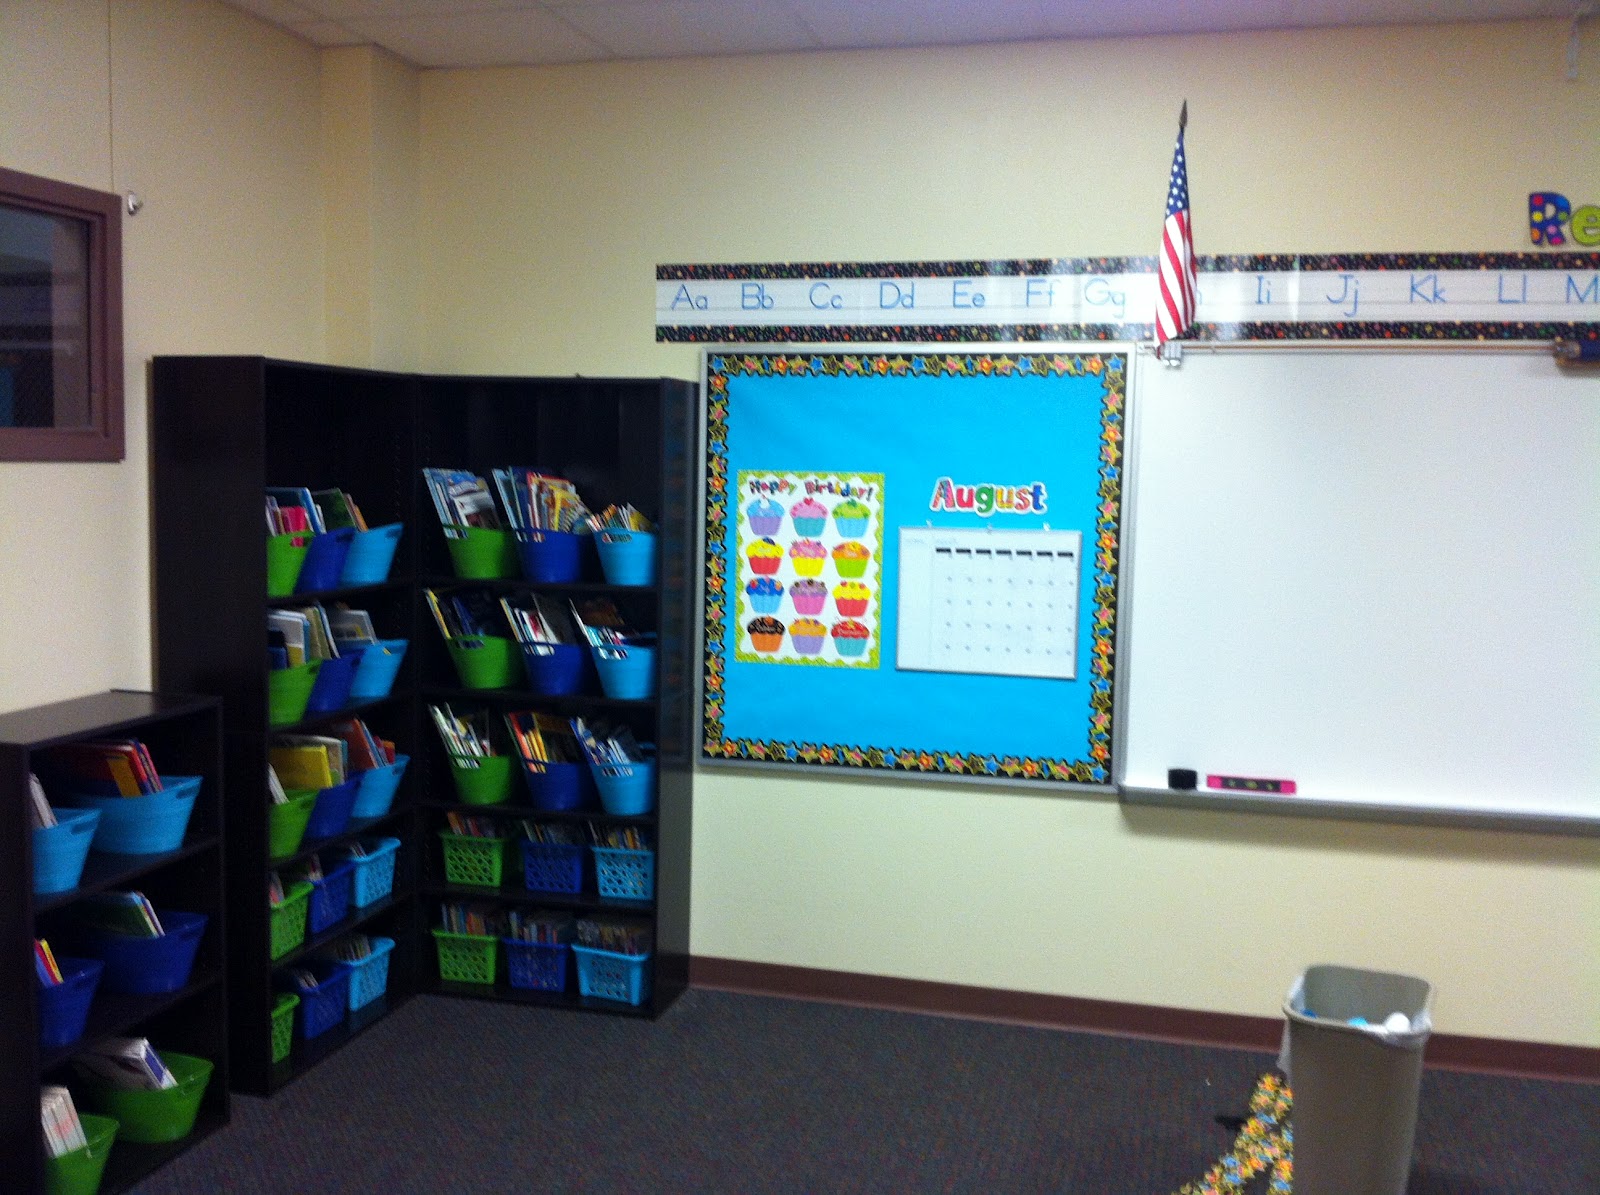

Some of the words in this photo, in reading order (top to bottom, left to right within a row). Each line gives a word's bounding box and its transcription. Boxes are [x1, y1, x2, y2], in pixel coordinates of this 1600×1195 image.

[1529, 192, 1600, 246] Re
[670, 283, 709, 311] Aa
[741, 282, 774, 311] Bb
[809, 283, 843, 310] Cc
[879, 281, 915, 310] Dd
[952, 280, 986, 309] Ee
[1026, 279, 1060, 307] Ff
[1084, 277, 1126, 318] Gg
[1254, 275, 1271, 305] Ii
[1325, 274, 1359, 317] Jj
[1410, 274, 1446, 303] Kk
[1498, 273, 1527, 304] Ll
[1565, 273, 1600, 304] M
[748, 478, 798, 496] Happy
[804, 478, 874, 501] Birthday!
[930, 478, 1046, 515] August
